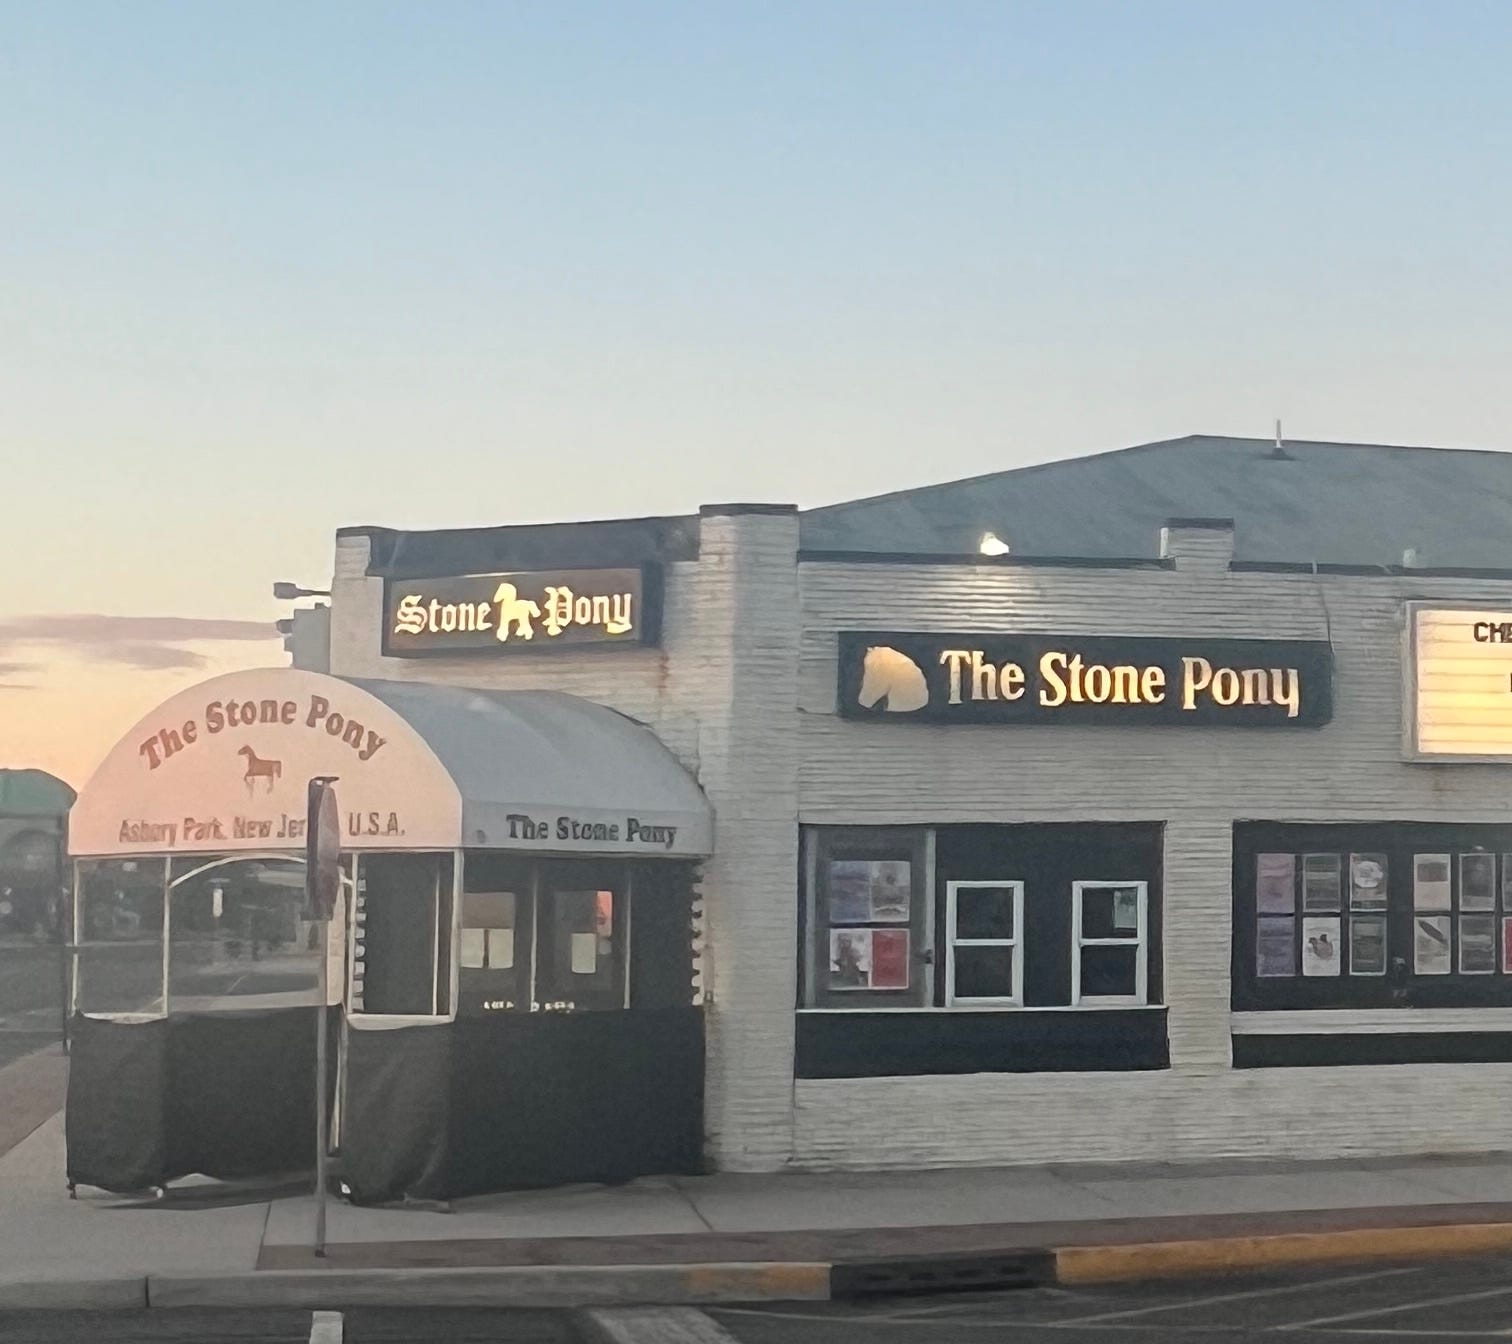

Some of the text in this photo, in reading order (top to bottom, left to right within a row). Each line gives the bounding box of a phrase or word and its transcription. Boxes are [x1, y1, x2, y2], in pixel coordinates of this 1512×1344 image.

[394, 585, 633, 637] Stone Pony
[940, 650, 1300, 718] The Stone Pony
[139, 694, 388, 770] The Stone Pony
[233, 815, 273, 840] New
[276, 813, 309, 839] Jer
[506, 813, 679, 850] The Stone Pony
